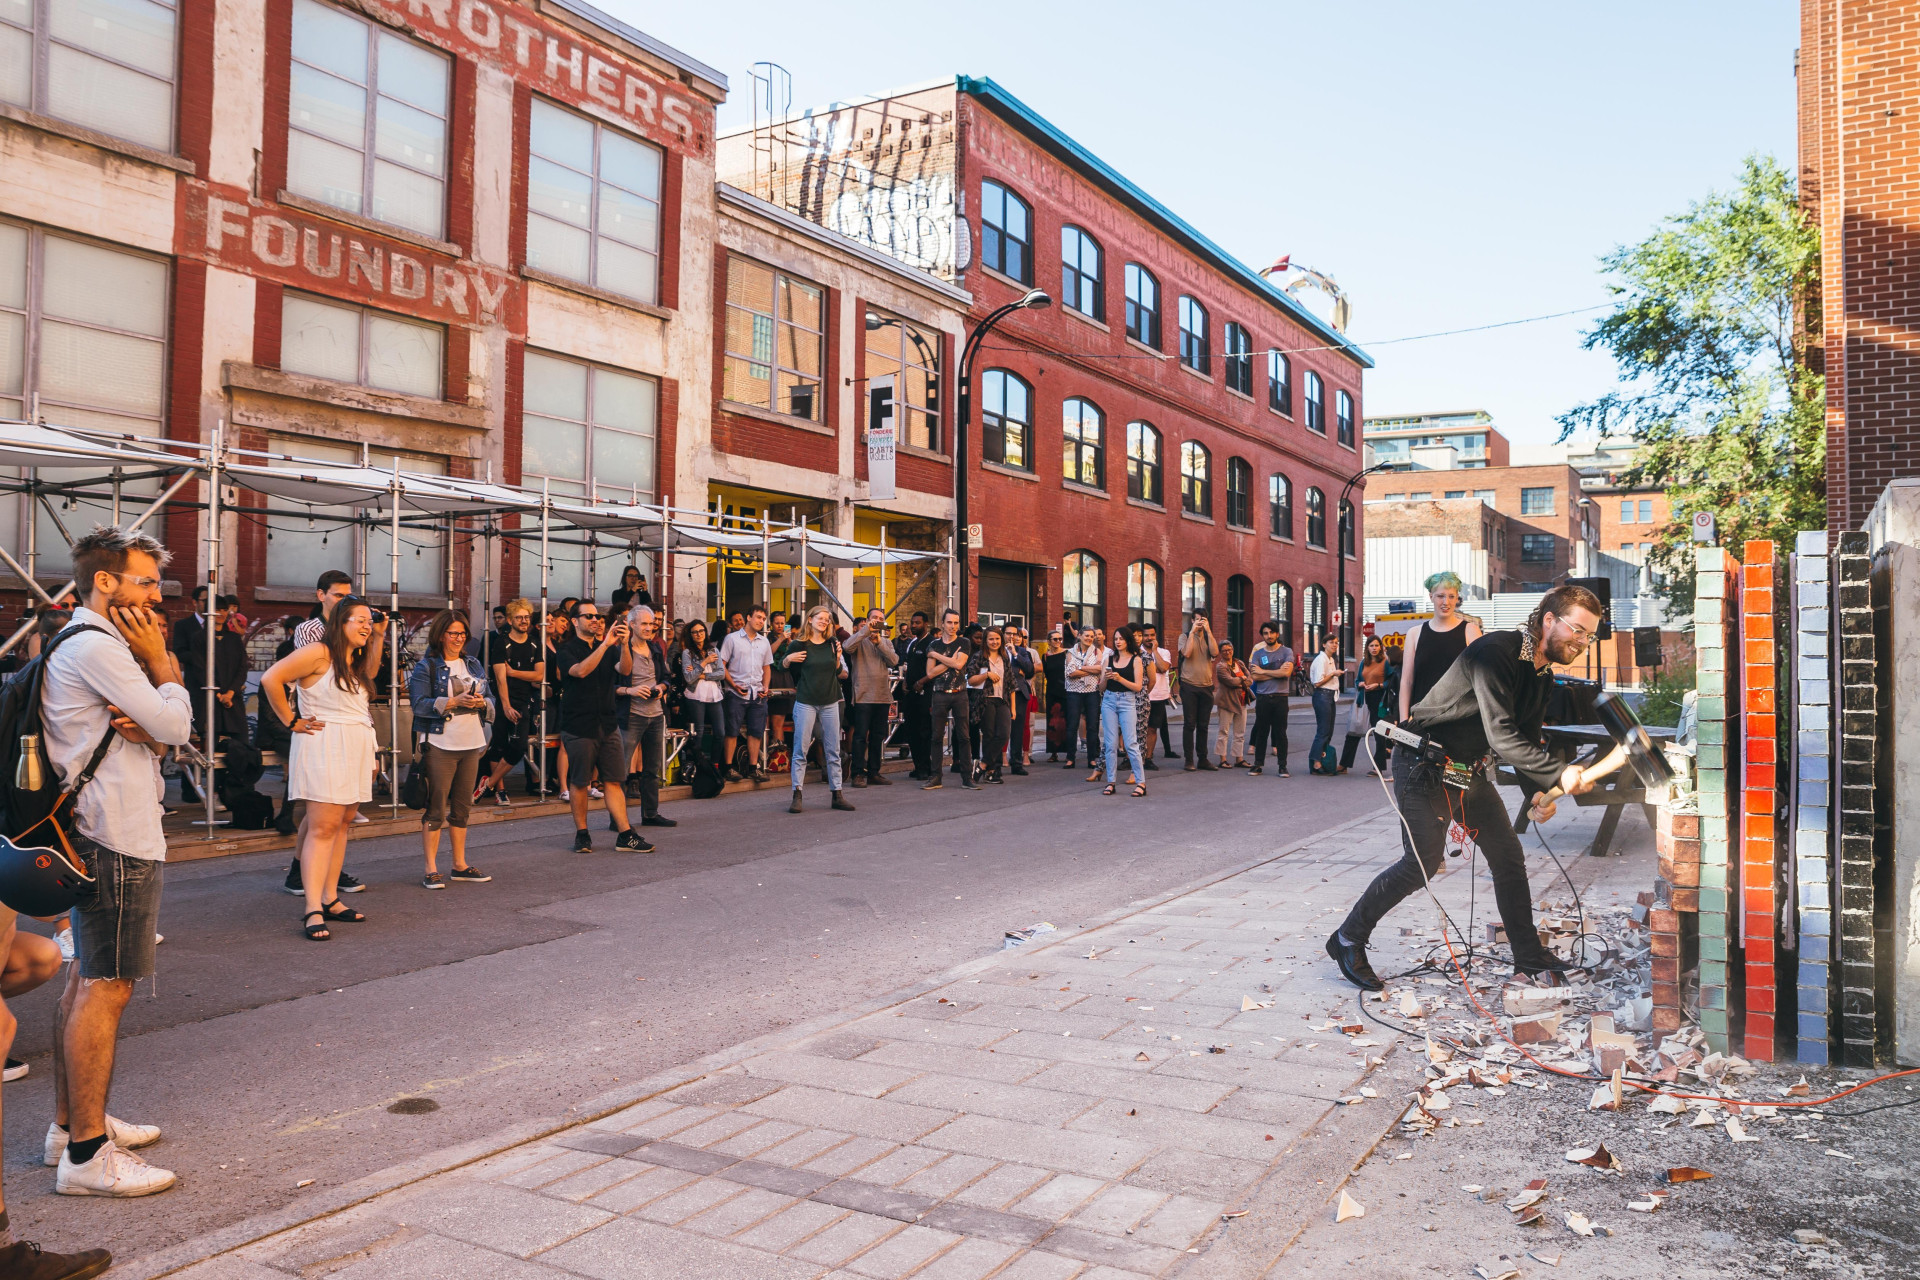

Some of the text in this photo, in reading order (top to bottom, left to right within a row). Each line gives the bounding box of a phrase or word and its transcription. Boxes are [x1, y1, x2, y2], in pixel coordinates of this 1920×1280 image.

[380, 0, 693, 140] OTHERS
[205, 196, 508, 323] FOUNDRY
[870, 386, 892, 430] F
